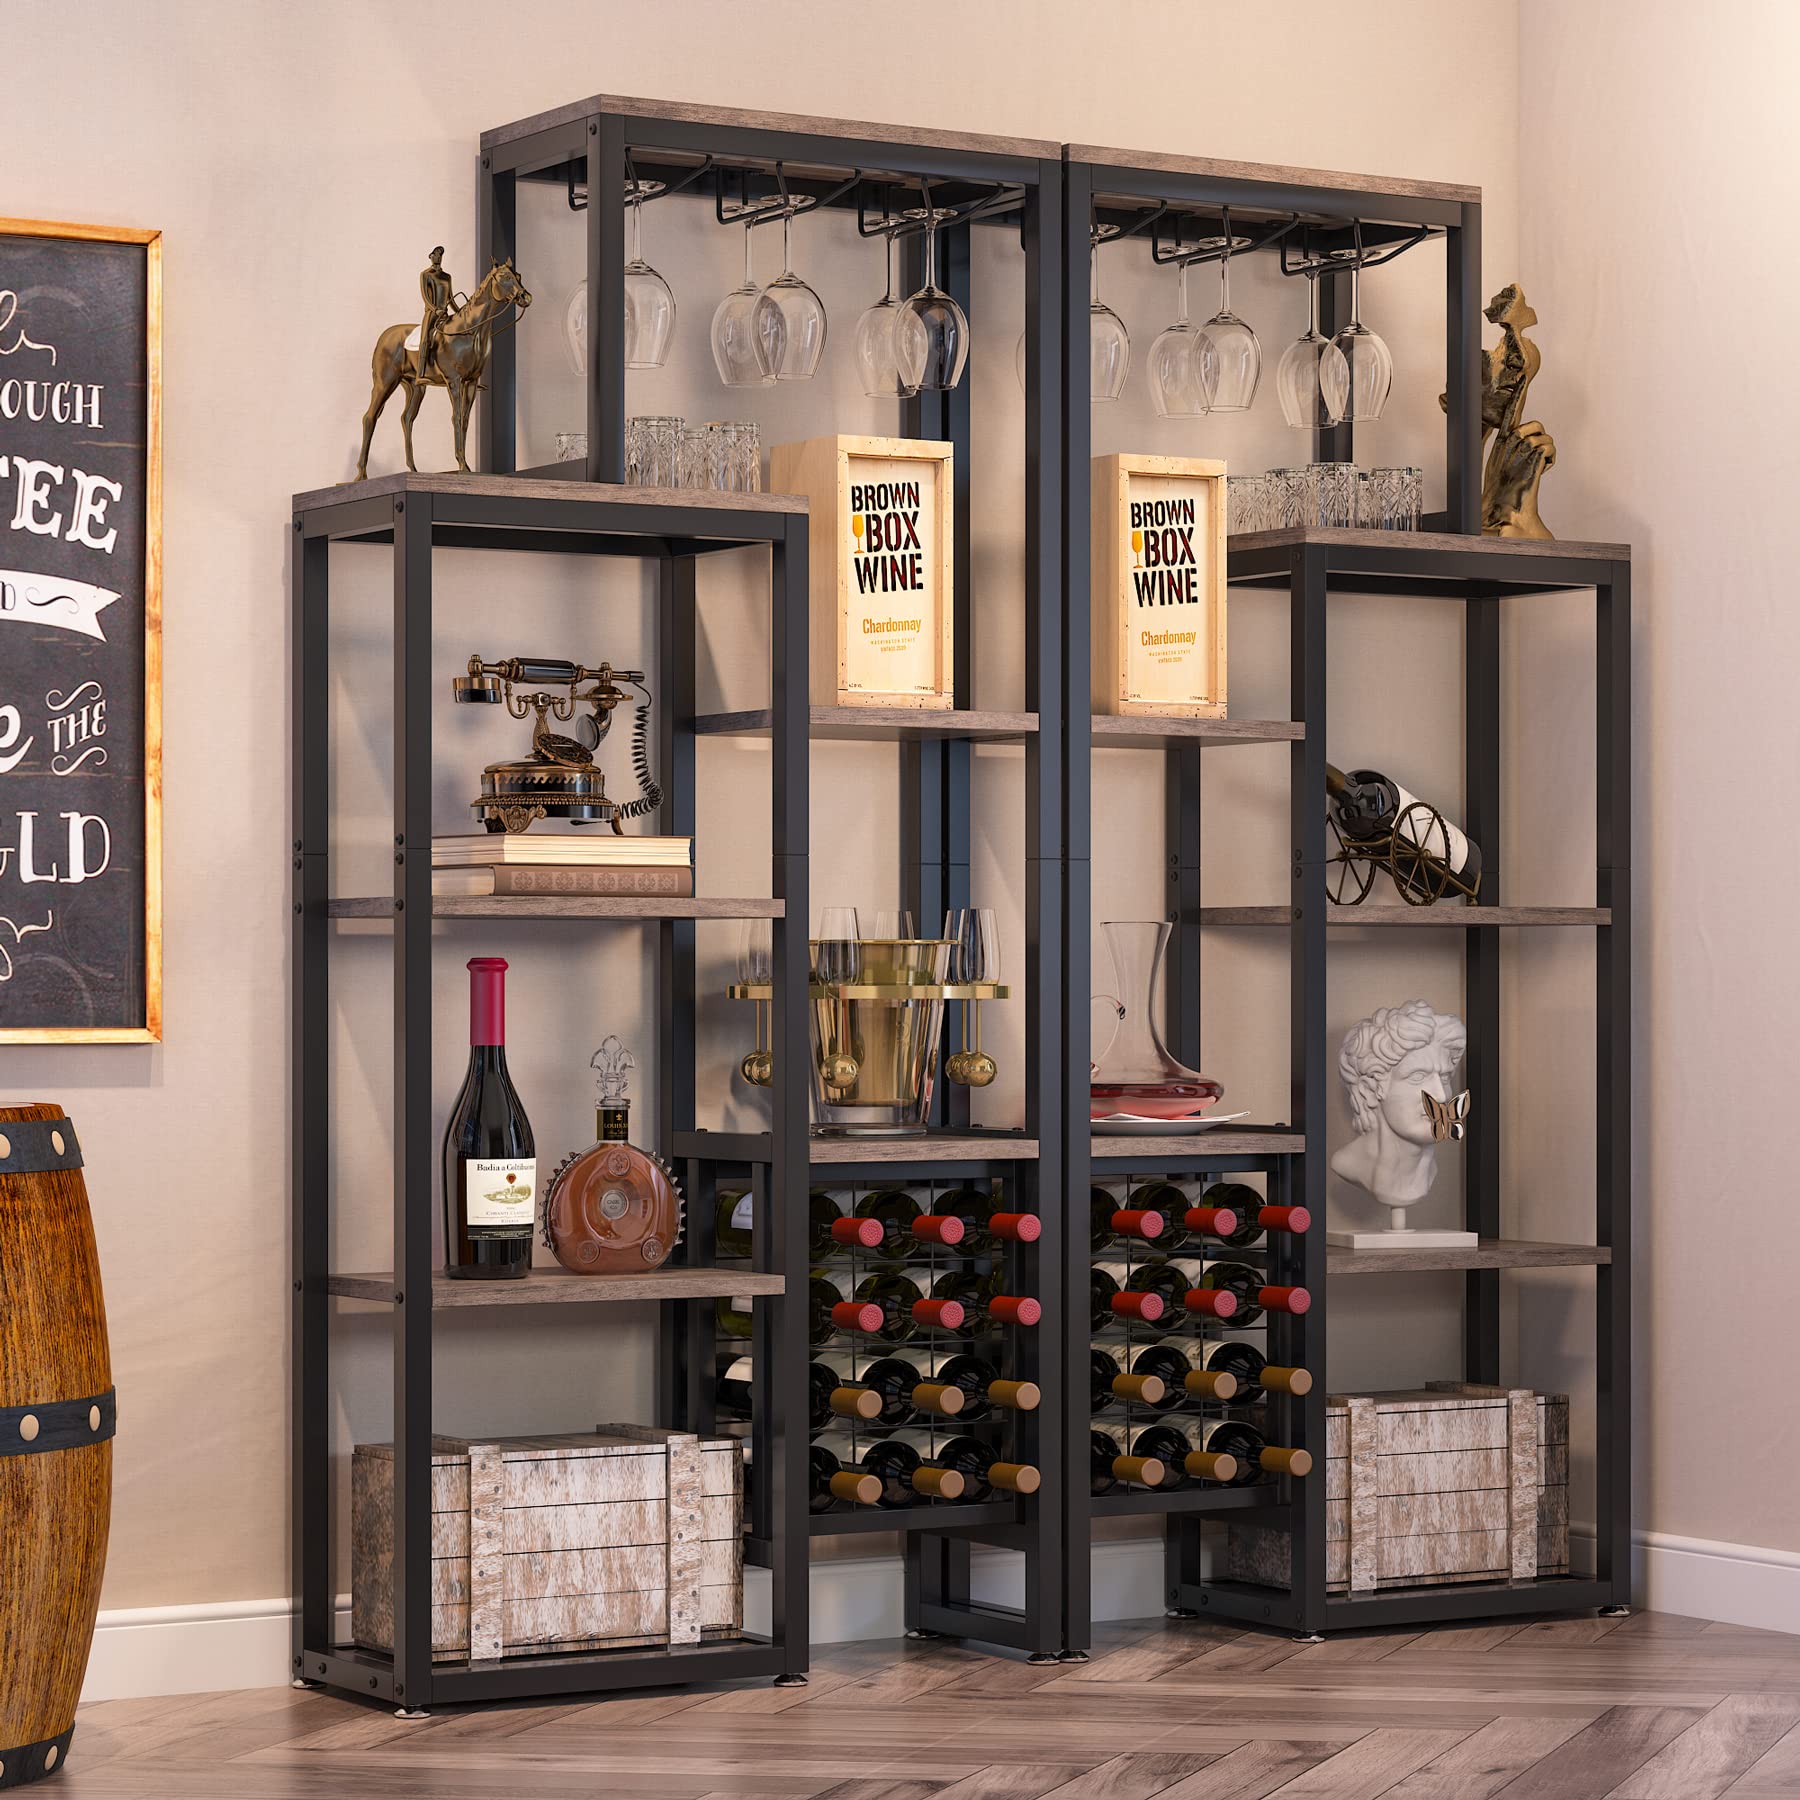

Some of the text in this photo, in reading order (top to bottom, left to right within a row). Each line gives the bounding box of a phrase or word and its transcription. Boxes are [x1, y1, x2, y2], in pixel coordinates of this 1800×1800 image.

[0, 455, 123, 555] EE
[851, 481, 920, 512] BROWN
[1130, 499, 1195, 528] BROWN
[865, 511, 921, 553] BOX
[1143, 527, 1196, 568] BOX
[854, 553, 924, 595] WINE
[1133, 568, 1198, 608] WINE
[862, 617, 922, 634] Chardonnay
[1141, 630, 1197, 646] Chardonnay
[47, 699, 107, 752] THE
[0, 811, 111, 884] LD
[476, 1163, 500, 1171] Badia
